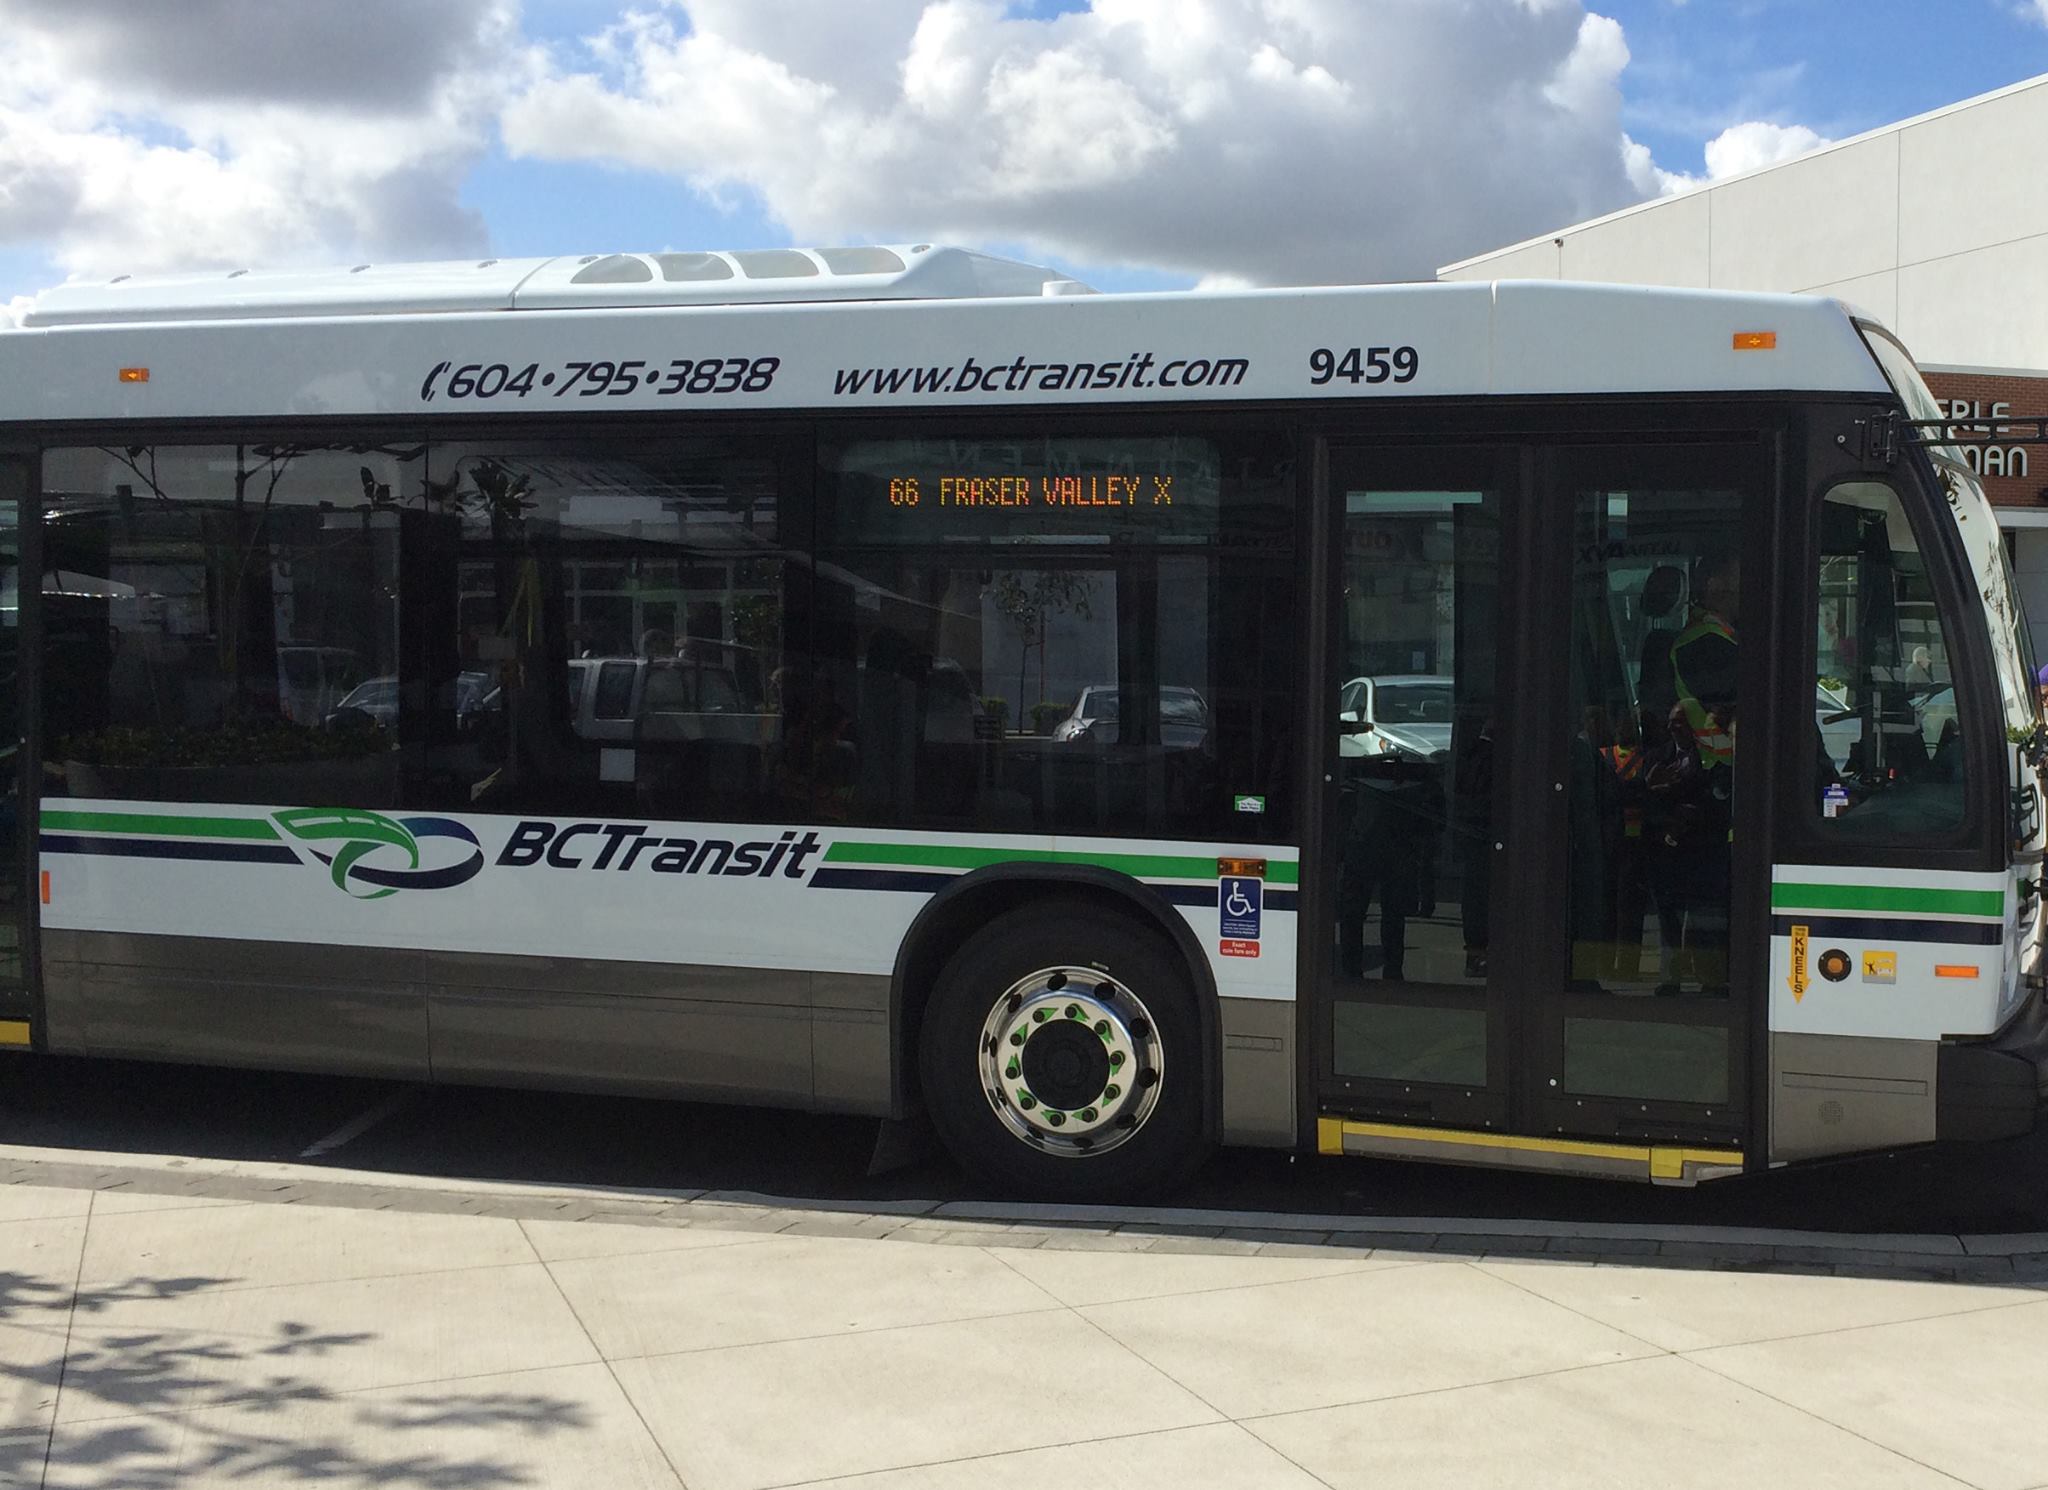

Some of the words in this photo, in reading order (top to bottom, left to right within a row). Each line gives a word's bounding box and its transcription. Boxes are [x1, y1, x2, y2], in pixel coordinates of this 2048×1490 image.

[833, 352, 1250, 395] www.bctransit.com
[1309, 345, 1419, 384] 9459
[888, 477, 919, 506] 66
[939, 476, 1030, 506] FRASER
[1042, 475, 1141, 505] VALLEY
[1152, 475, 1172, 505] X
[494, 820, 820, 878] BCTransit
[1794, 937, 1803, 993] KNEELS
